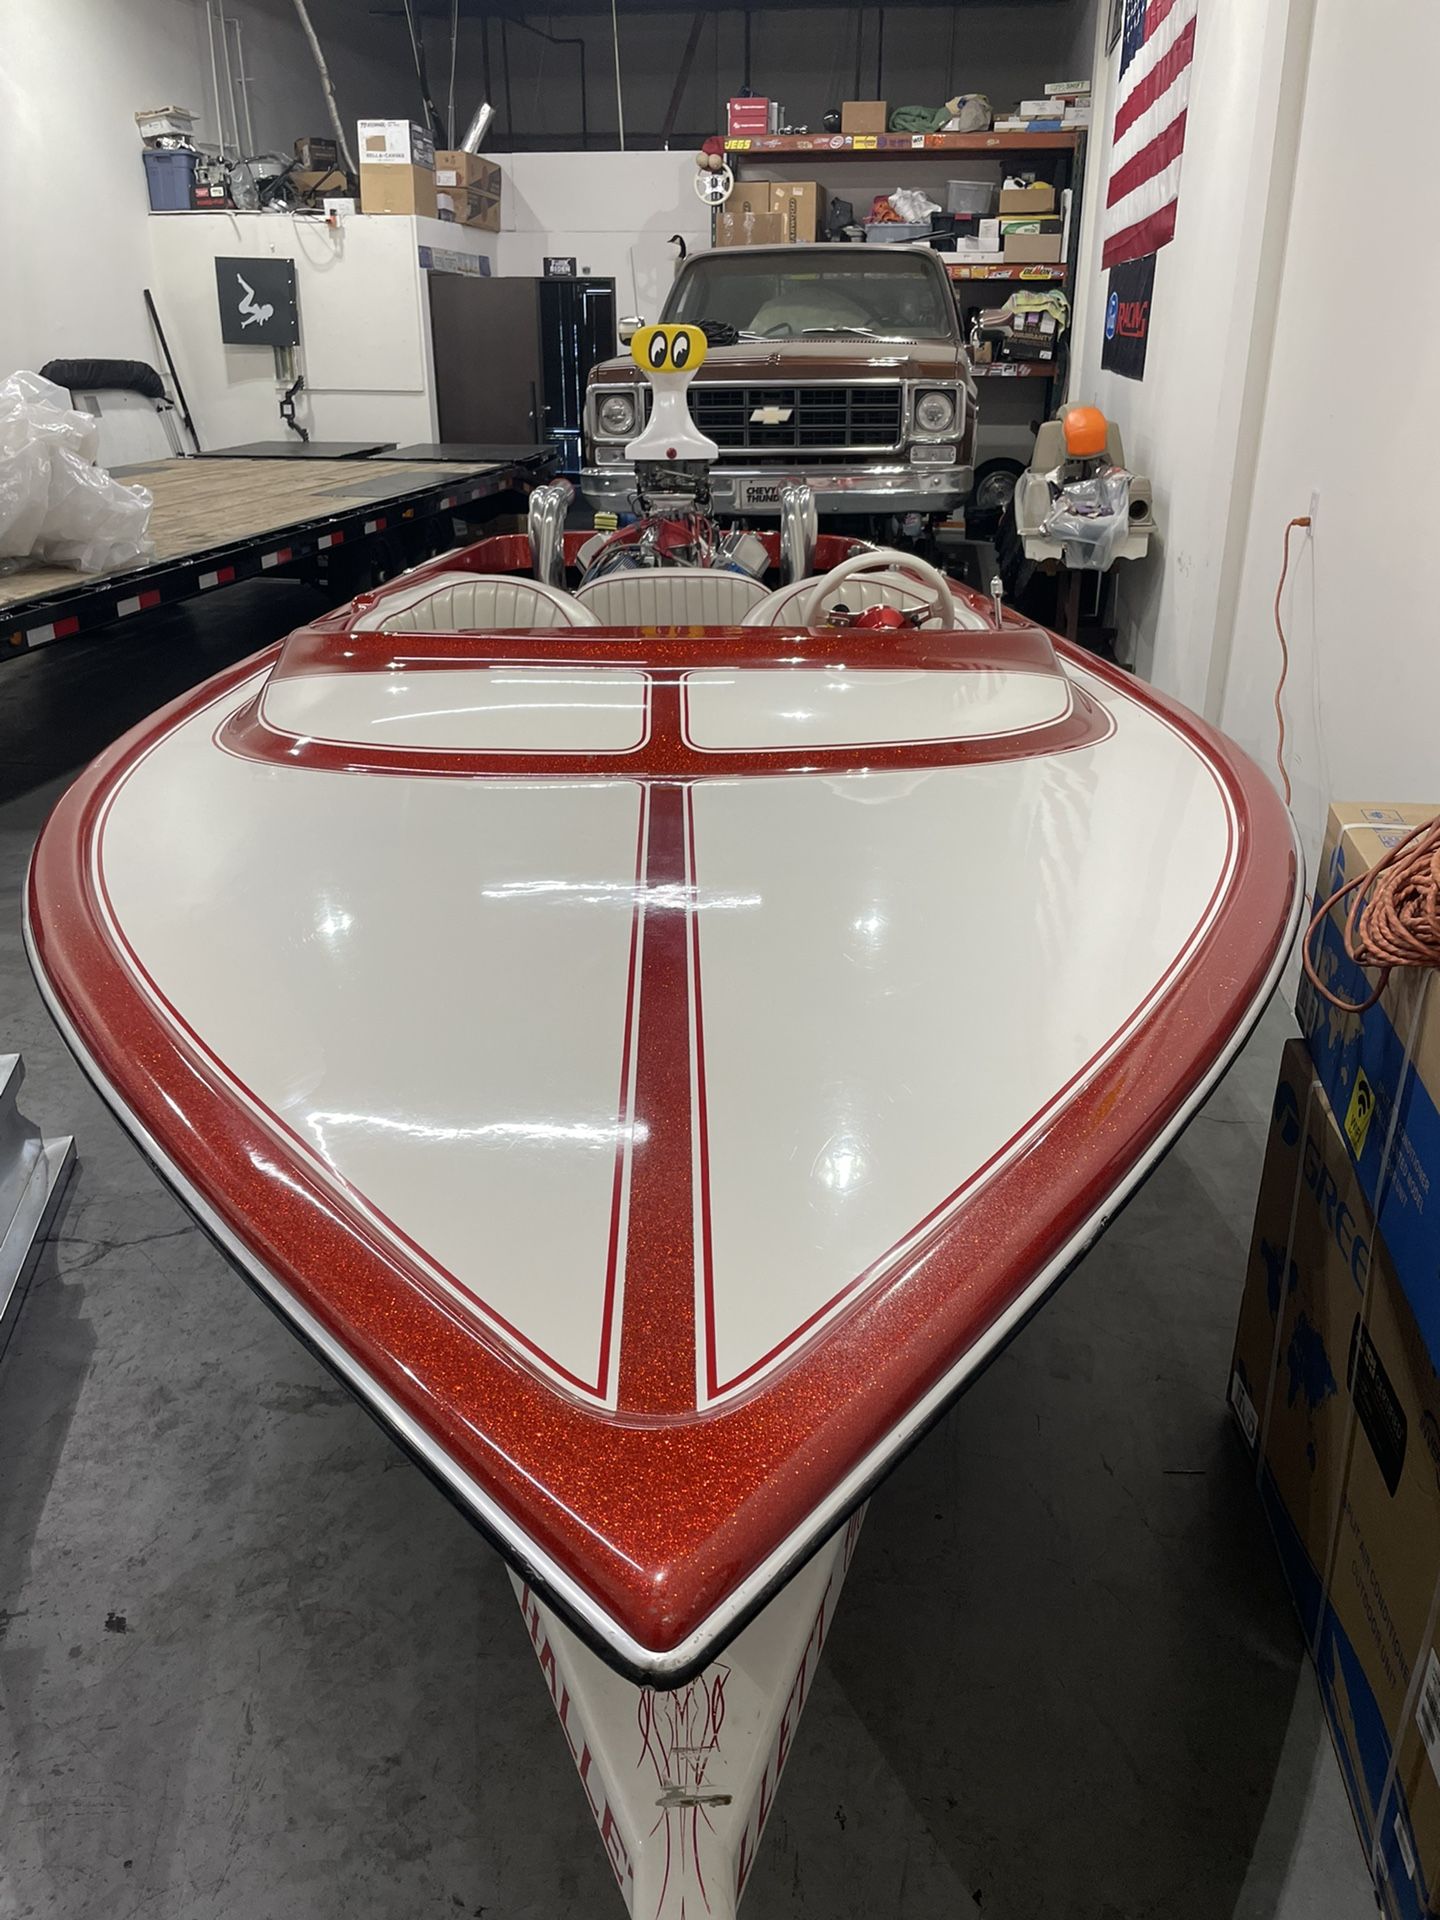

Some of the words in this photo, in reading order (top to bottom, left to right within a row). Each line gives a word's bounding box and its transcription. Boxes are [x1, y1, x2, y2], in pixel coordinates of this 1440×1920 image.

[724, 140, 752, 150] JEGS
[1116, 301, 1149, 337] RACING
[746, 487, 776, 495] CHEVY
[746, 495, 780, 503] THUND
[1303, 1134, 1373, 1297] GREE
[1351, 1560, 1381, 1649] OUTDOOR
[1382, 1645, 1397, 1689] UNIT
[520, 1582, 633, 1887] HALLE
